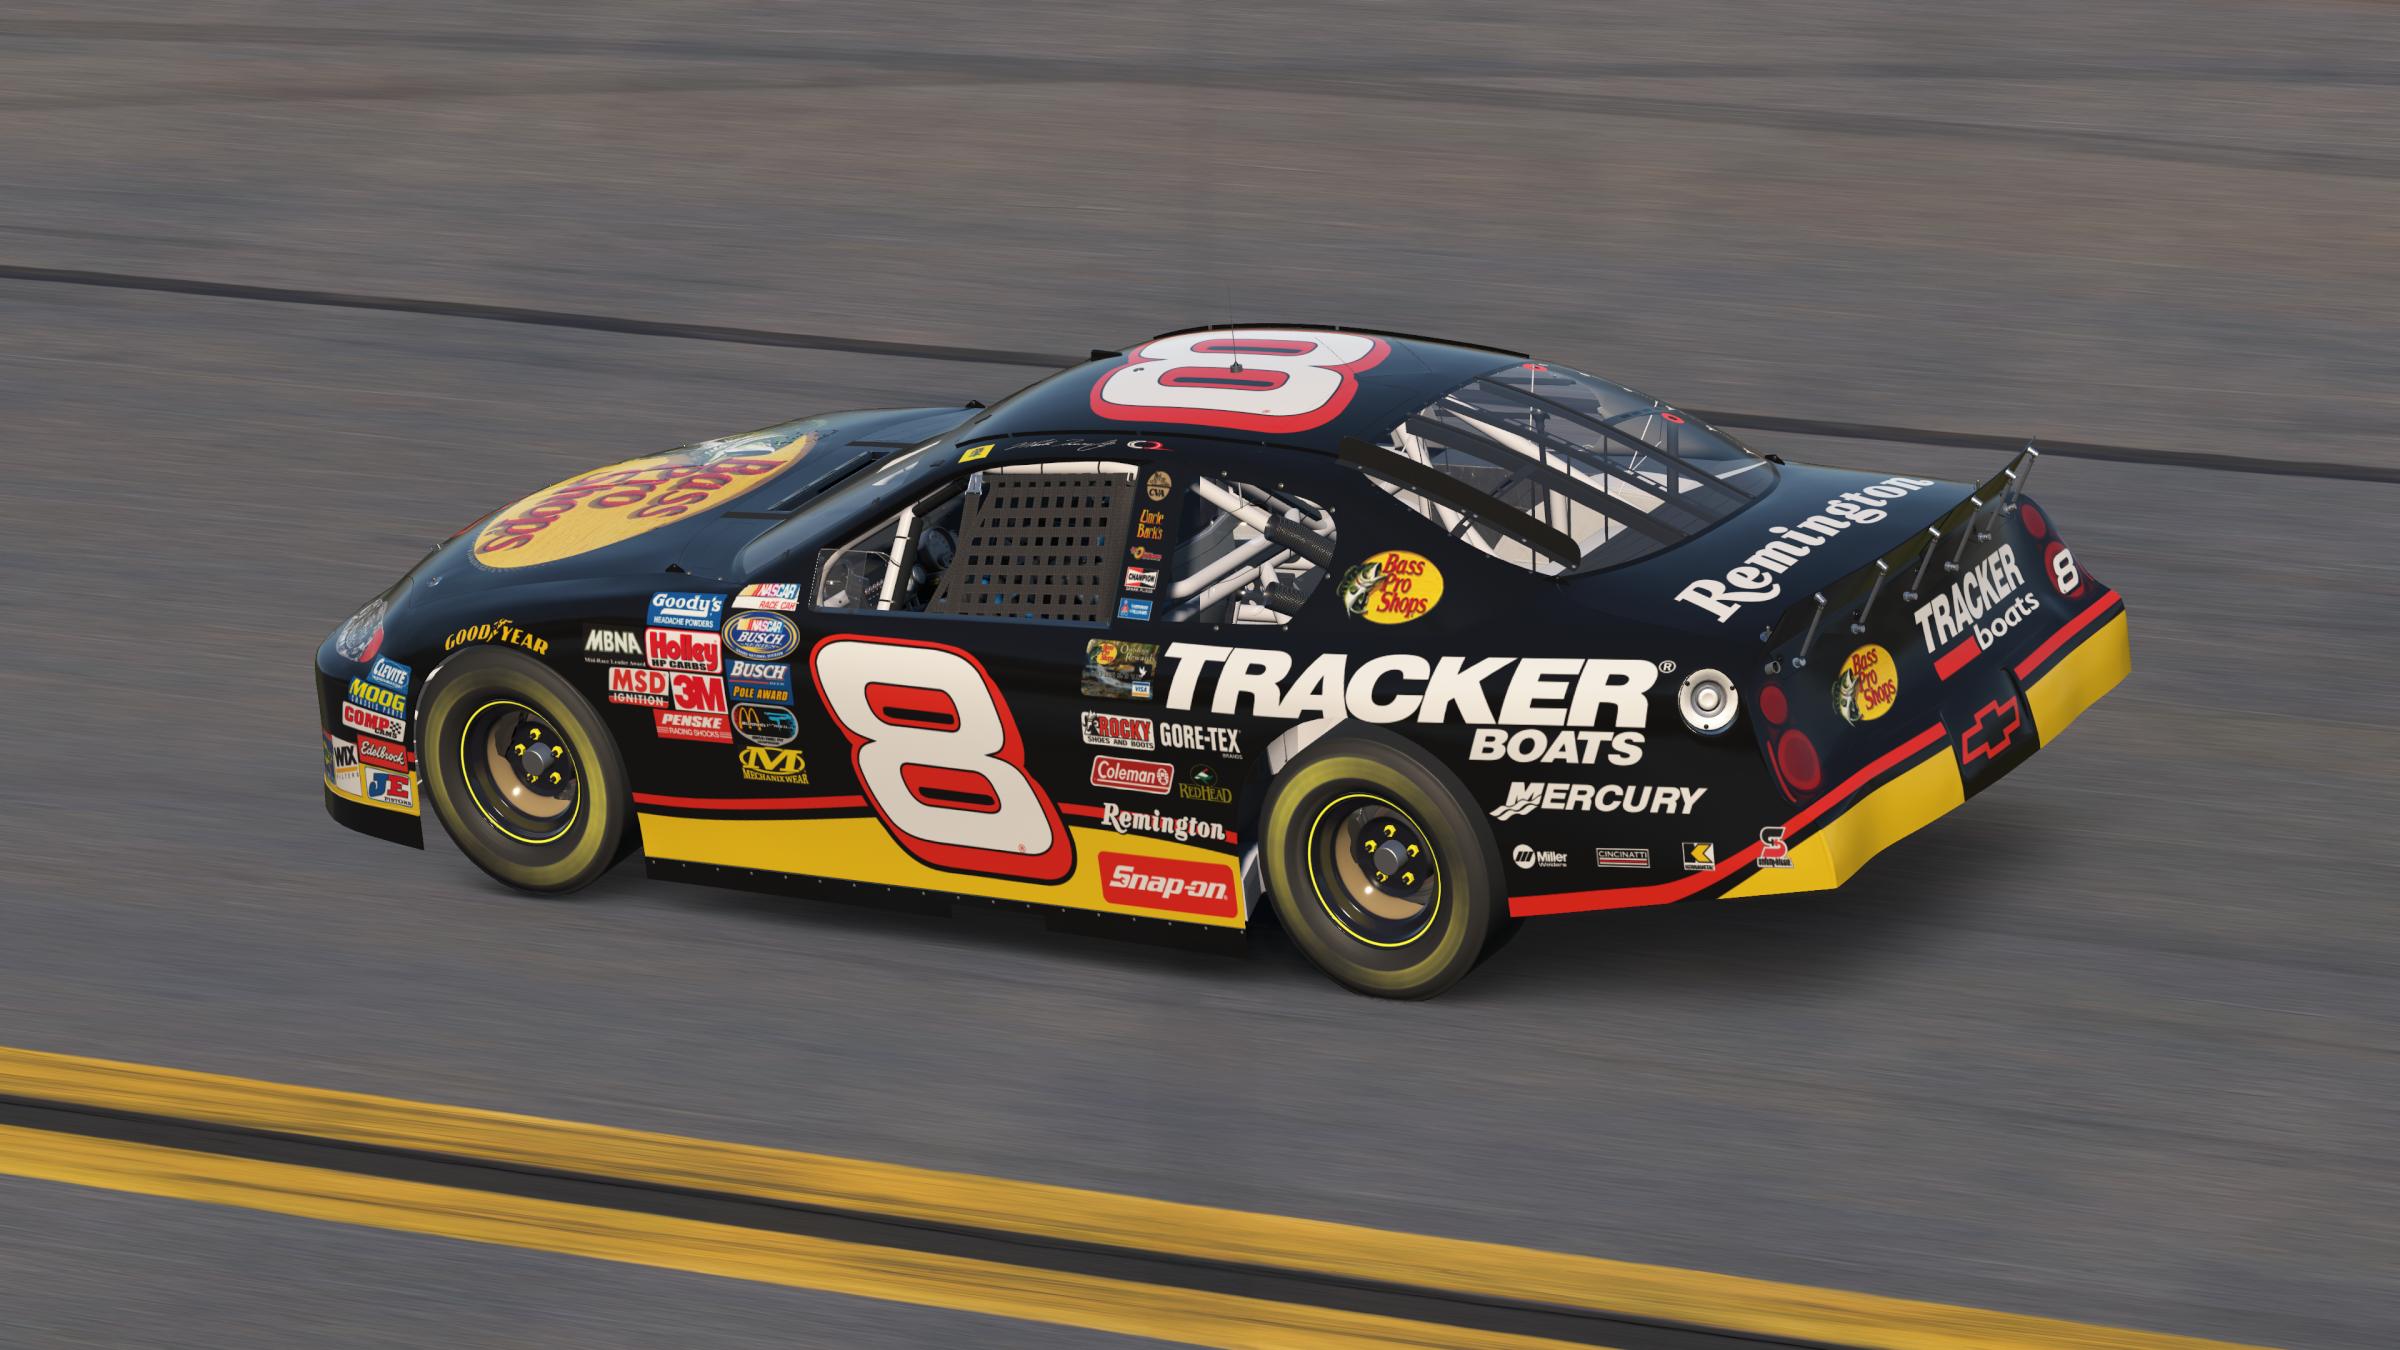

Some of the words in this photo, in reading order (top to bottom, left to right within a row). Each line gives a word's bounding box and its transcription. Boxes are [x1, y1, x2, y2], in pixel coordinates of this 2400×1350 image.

[1095, 327, 1386, 426] 8
[630, 459, 788, 519] Bass
[1674, 477, 1935, 623] Remington
[1383, 553, 1426, 576] Bass
[2053, 548, 2079, 594] 8
[759, 583, 797, 599] NASCAR
[1380, 573, 1412, 593] Pro
[652, 593, 722, 617] Goody's
[760, 601, 778, 609] RACE
[781, 602, 796, 610] CAR
[1376, 592, 1428, 619] Shops
[1914, 543, 2026, 654] TRACKER
[653, 616, 684, 625] HEADACHE
[685, 619, 714, 628] POWDERS
[752, 619, 784, 633] NASCAR
[1973, 592, 2040, 651] boats
[584, 629, 644, 655] MBNA
[737, 631, 785, 645] BUSCH
[649, 631, 718, 672] Holley
[1852, 648, 1878, 676] Bass
[373, 658, 407, 685] CLEVITE
[669, 660, 707, 670] CARBS
[731, 661, 787, 679] BUSCH
[613, 668, 666, 694] MSD
[673, 674, 726, 712] 3M
[733, 686, 754, 698] POLE
[756, 689, 788, 701] AWARD
[1859, 669, 1878, 693] Pro
[1864, 678, 1896, 710] Shops
[349, 678, 407, 712] MOOG
[613, 692, 664, 706] IGNITION
[344, 705, 390, 730] COMP
[661, 713, 722, 729] PENSKE
[1099, 715, 1151, 742] ROCKY
[668, 727, 693, 736] RACING
[694, 729, 720, 738] SHOCKS
[1087, 735, 1110, 745] SHOES
[1113, 738, 1128, 746] AND
[1130, 740, 1154, 749] BOOTS
[1159, 722, 1241, 754] GORE-TEX
[334, 746, 357, 767] WIX
[360, 741, 405, 765] Edelbrock
[811, 635, 1070, 876] 8
[1469, 728, 1646, 766] BOATS
[369, 772, 409, 799] JE
[784, 774, 809, 785] WEAR
[1098, 760, 1156, 785] Coleman
[1490, 781, 1708, 821] MERCURY
[1101, 802, 1226, 842] Remington
[1537, 851, 1568, 862] Miller
[1109, 865, 1228, 901] Snap-on
